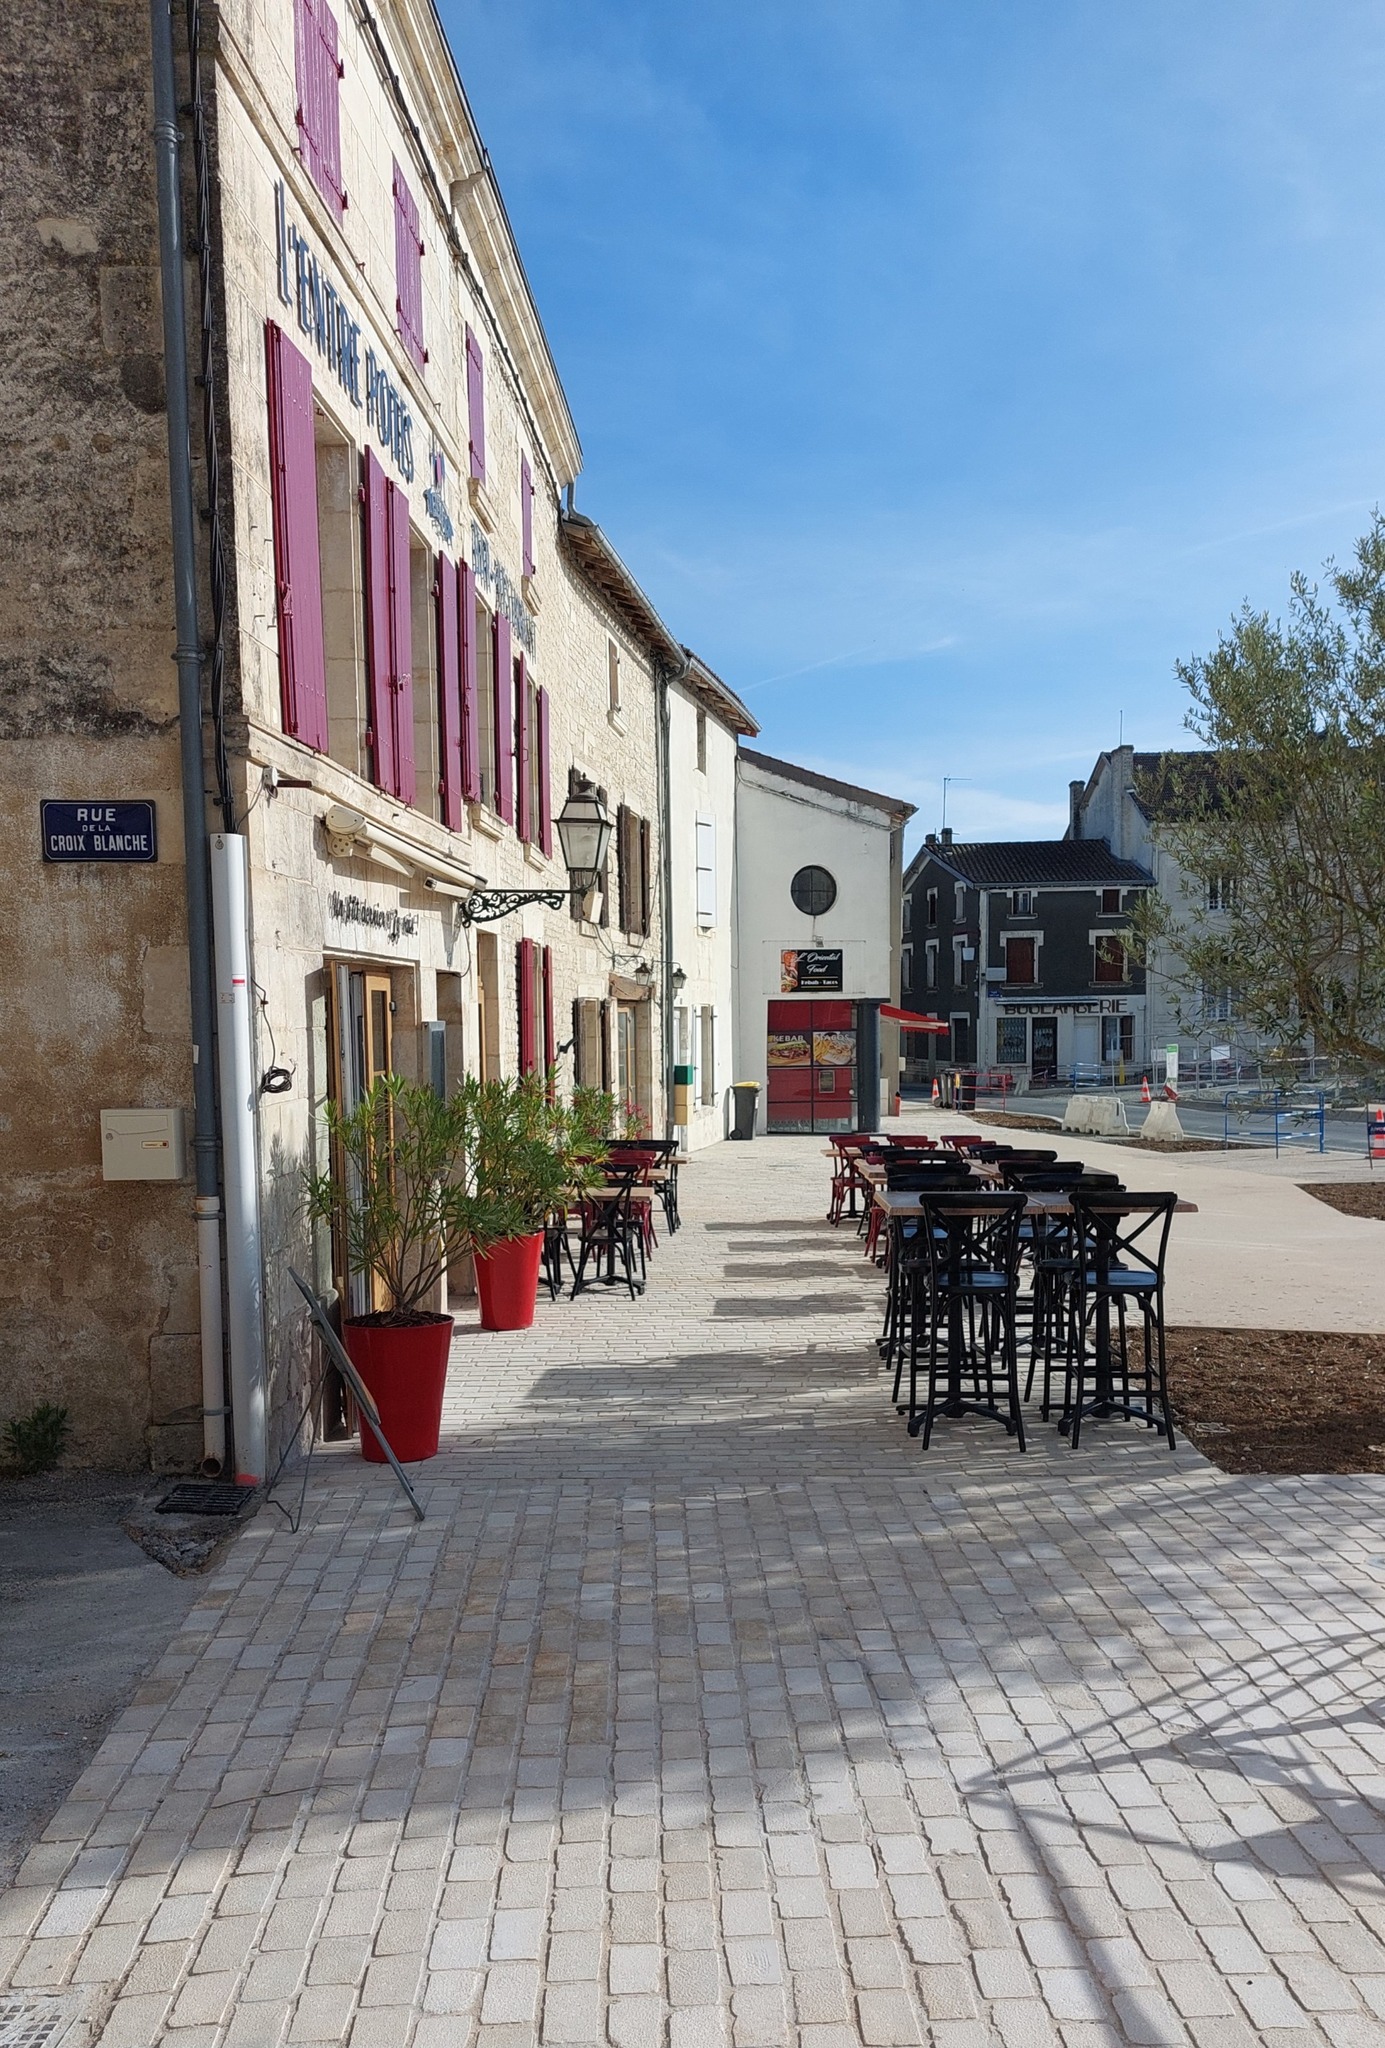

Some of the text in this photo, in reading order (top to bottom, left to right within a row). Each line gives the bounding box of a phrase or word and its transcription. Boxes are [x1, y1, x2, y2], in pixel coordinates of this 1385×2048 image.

[275, 177, 413, 484] L'ENTRE POTES
[77, 808, 116, 821] RUE
[82, 824, 111, 832] DE LA
[50, 834, 149, 851] CROIX BLANCHE
[806, 964, 828, 974] Food
